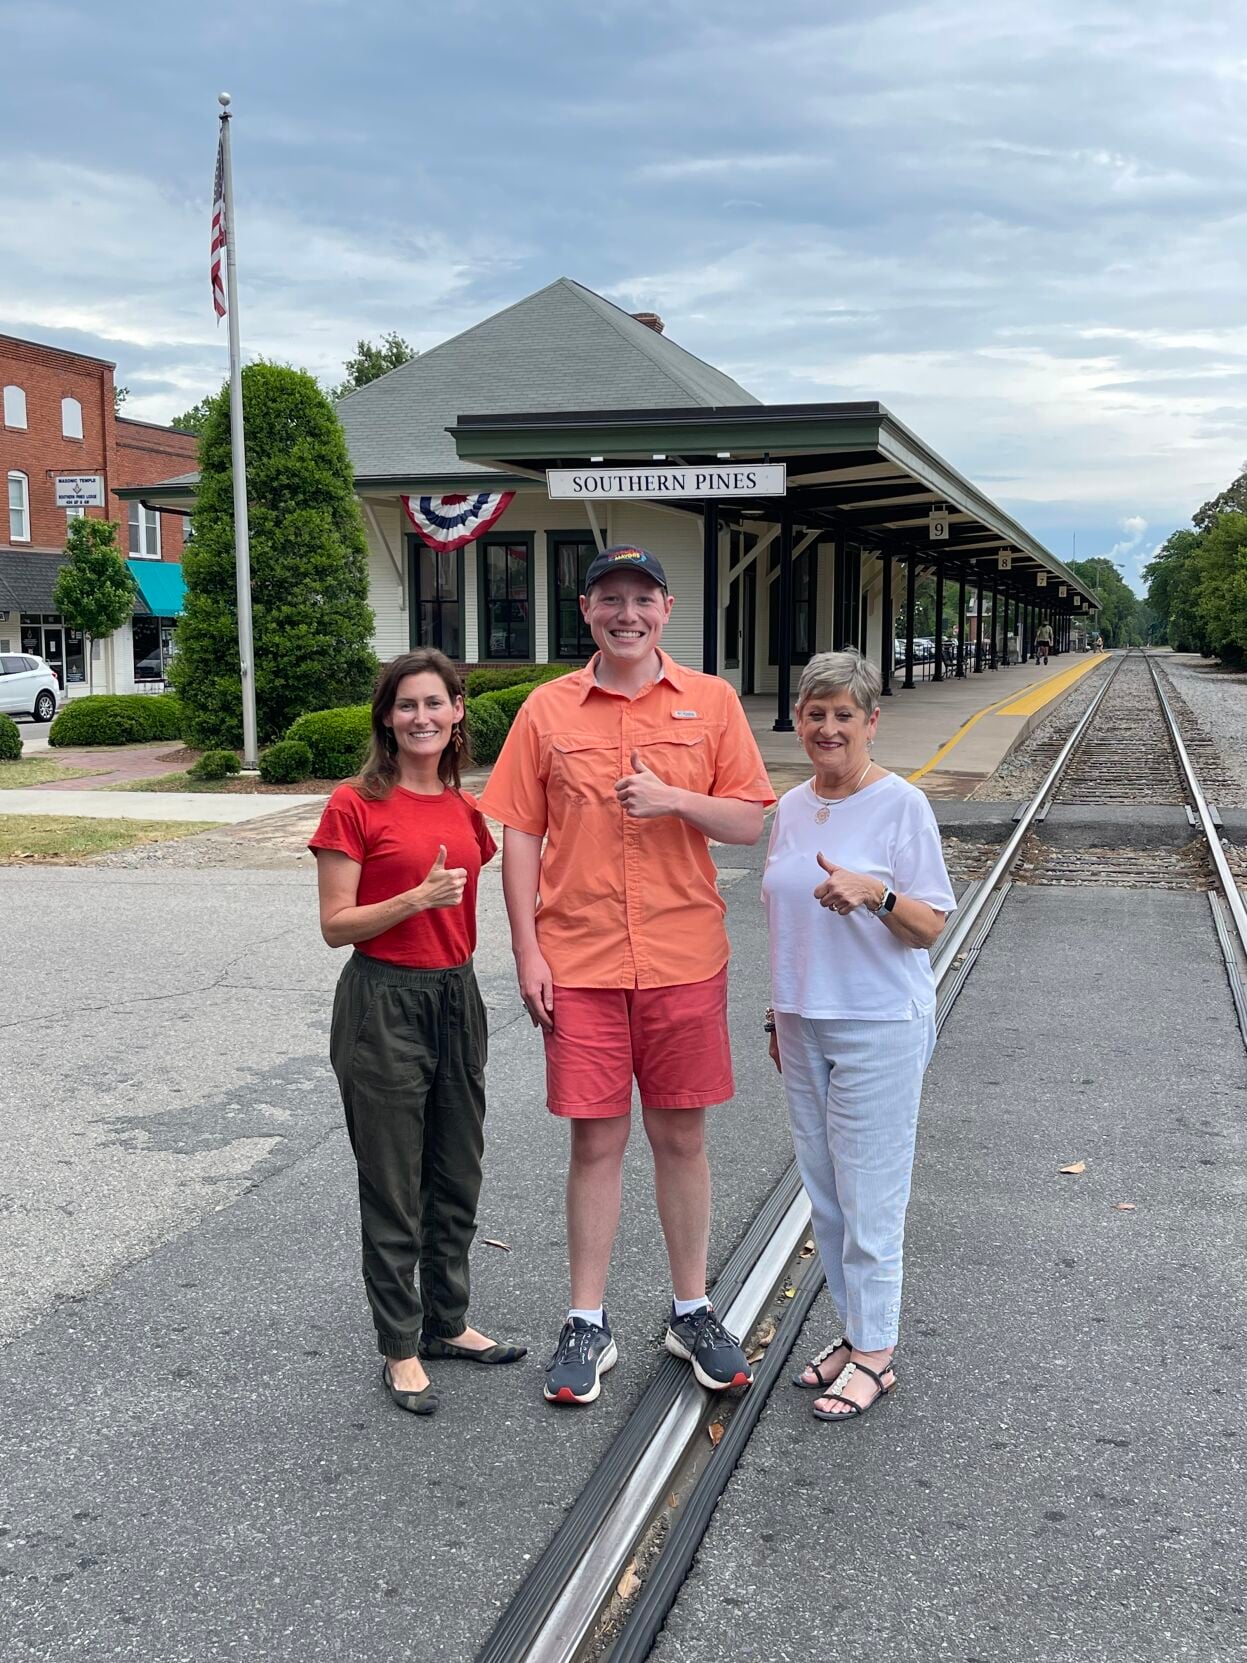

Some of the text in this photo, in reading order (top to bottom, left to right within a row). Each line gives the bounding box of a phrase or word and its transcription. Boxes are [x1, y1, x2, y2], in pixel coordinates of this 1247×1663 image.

[573, 472, 757, 493] SOUTHERN PINES
[934, 522, 944, 537] 9
[1001, 558, 1008, 568] 8
